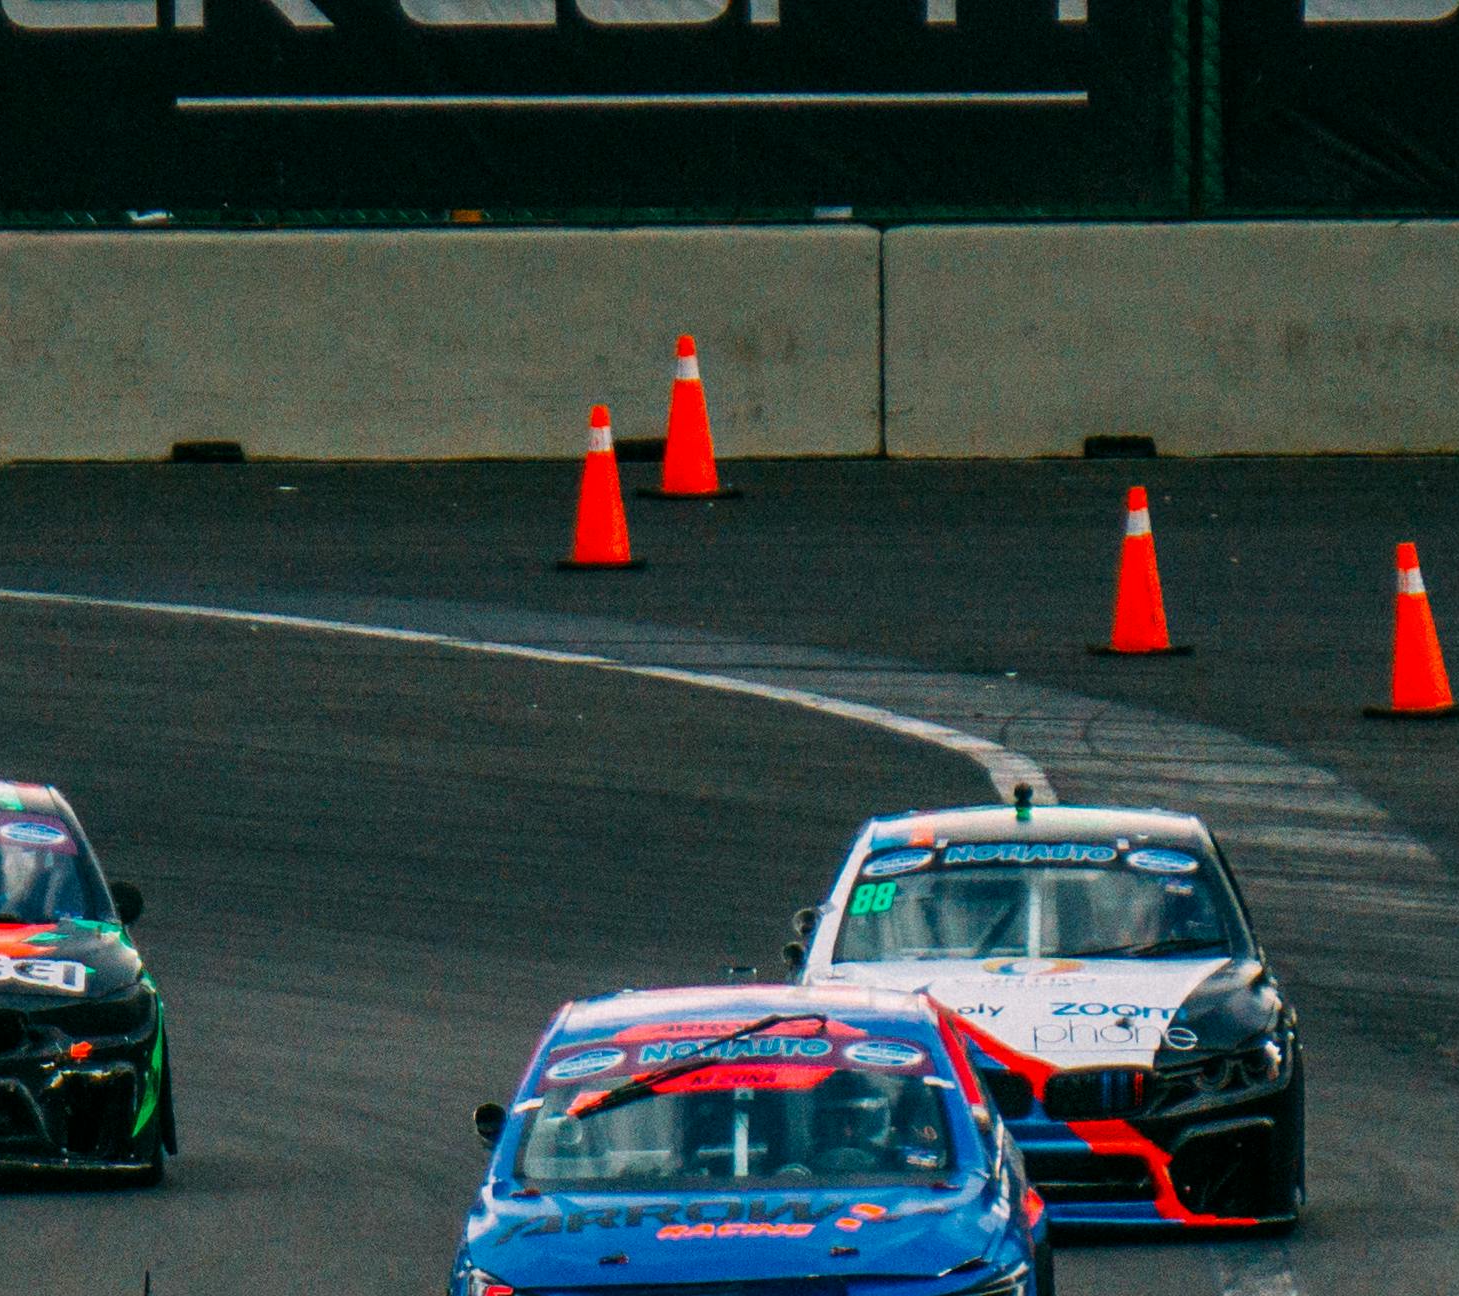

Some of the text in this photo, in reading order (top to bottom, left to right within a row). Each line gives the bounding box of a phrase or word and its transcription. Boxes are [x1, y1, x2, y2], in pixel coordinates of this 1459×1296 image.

[944, 843, 1118, 864] NOTIAUTO
[848, 881, 896, 917] 88
[955, 1001, 1006, 1018] oly
[1033, 1019, 1199, 1052] phone
[637, 1037, 833, 1066] NOTIAUTO
[495, 1199, 847, 1247] ARROW
[655, 1222, 817, 1241] RACING
